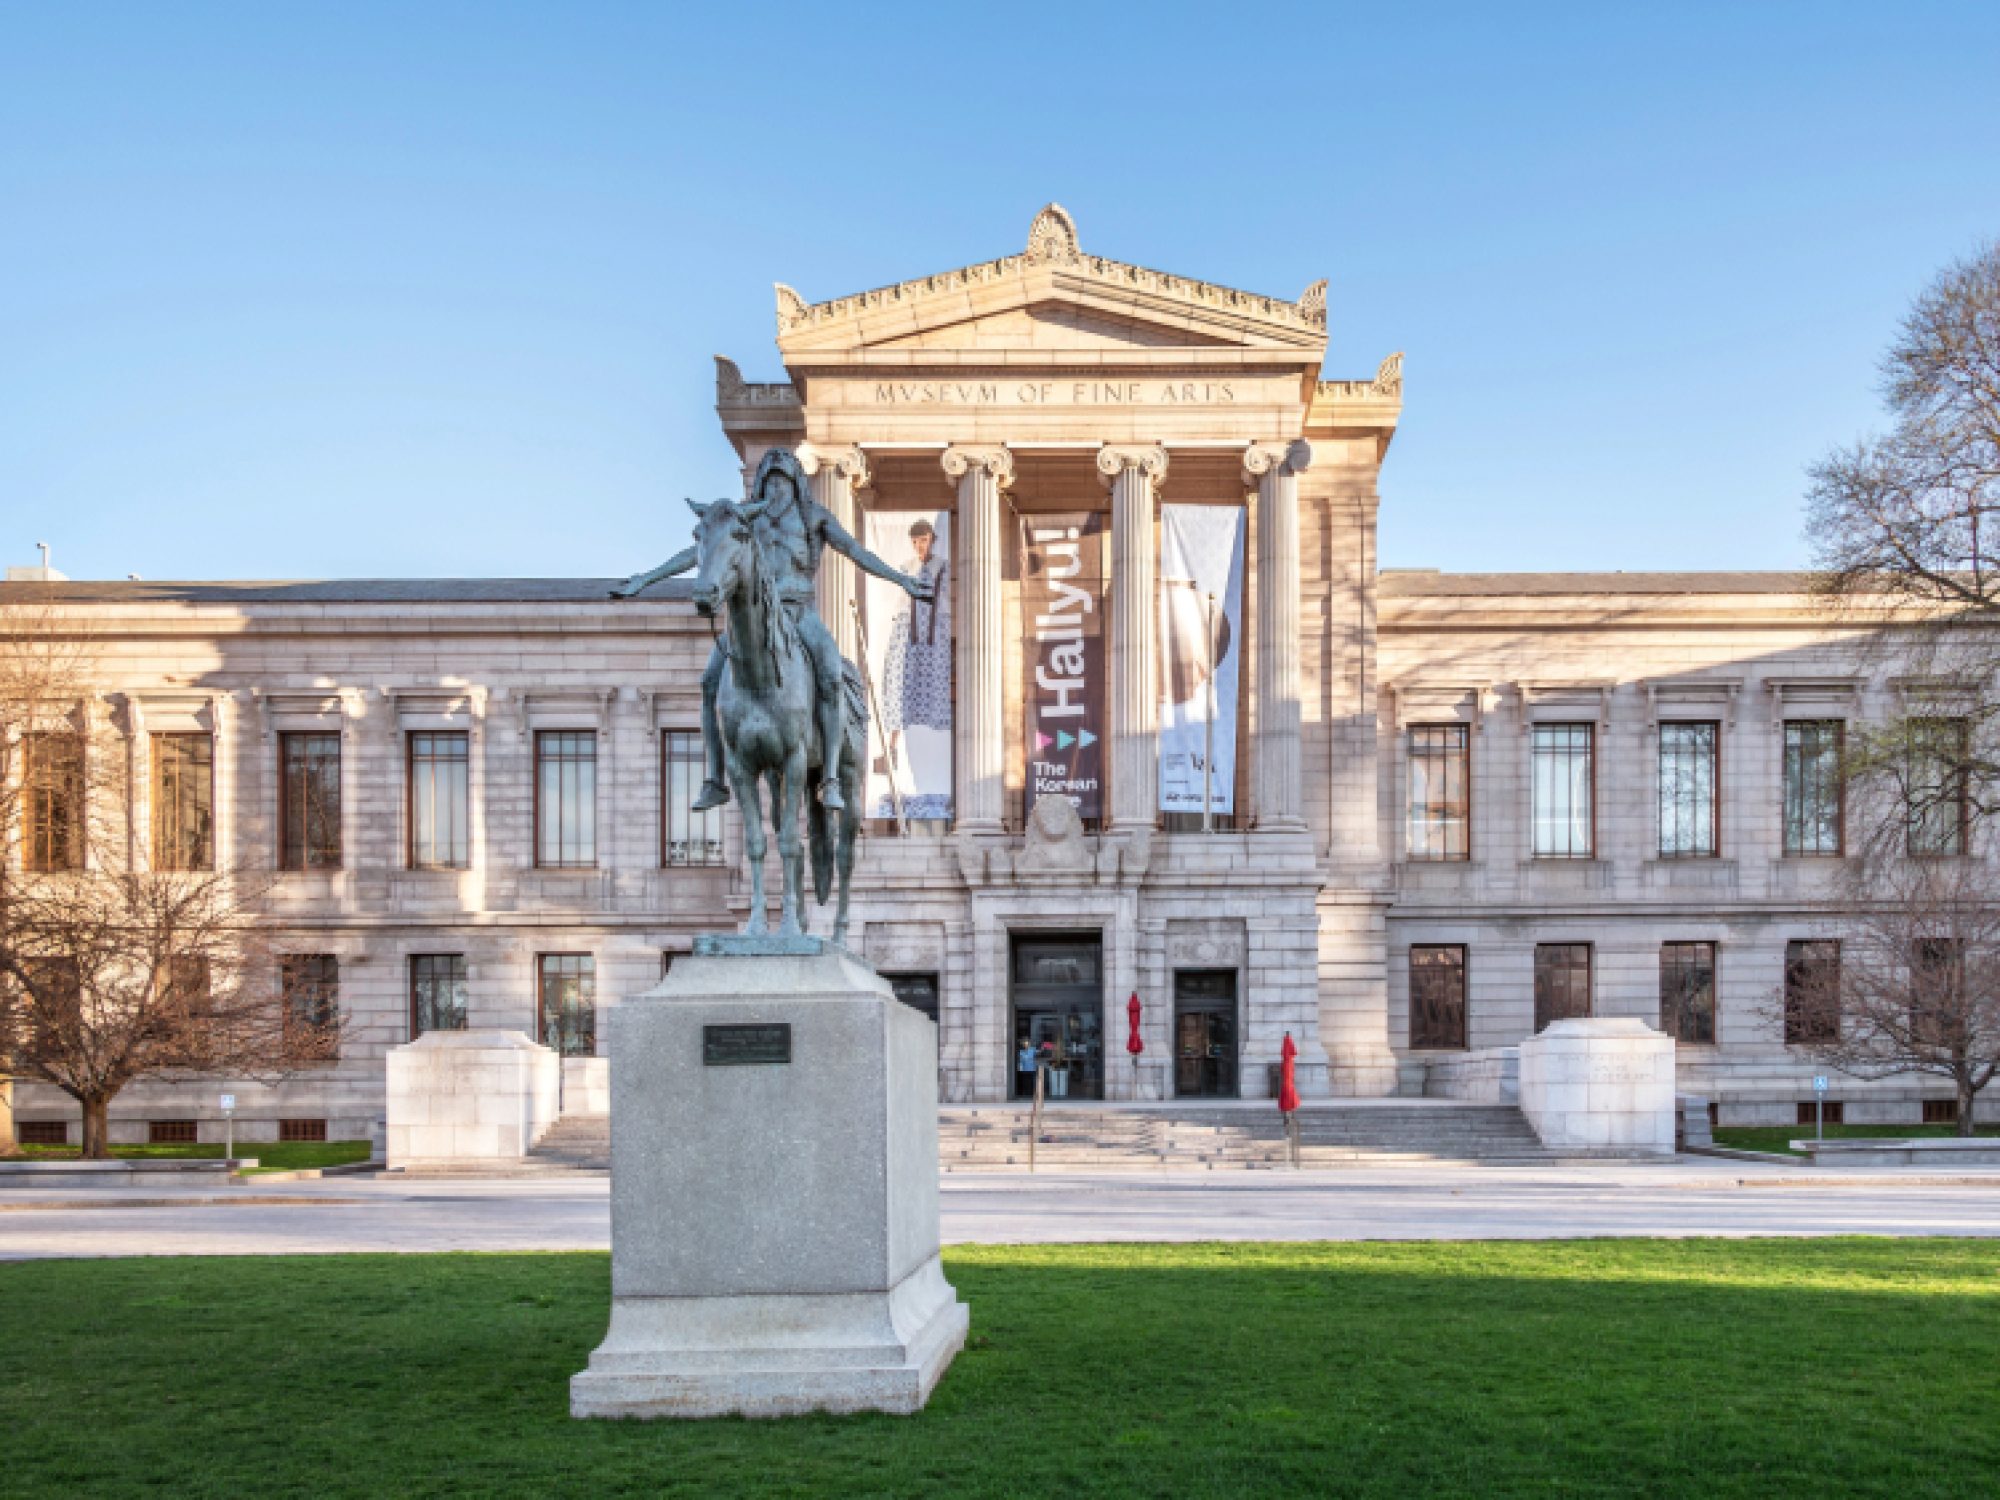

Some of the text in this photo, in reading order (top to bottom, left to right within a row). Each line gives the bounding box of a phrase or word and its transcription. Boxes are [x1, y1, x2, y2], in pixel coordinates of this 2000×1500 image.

[876, 383, 1234, 403] MVSEVM OF FINE ARTS
[1035, 527, 1092, 717] Hallyu!
[1033, 761, 1066, 776] The
[1035, 777, 1098, 792] Korean
